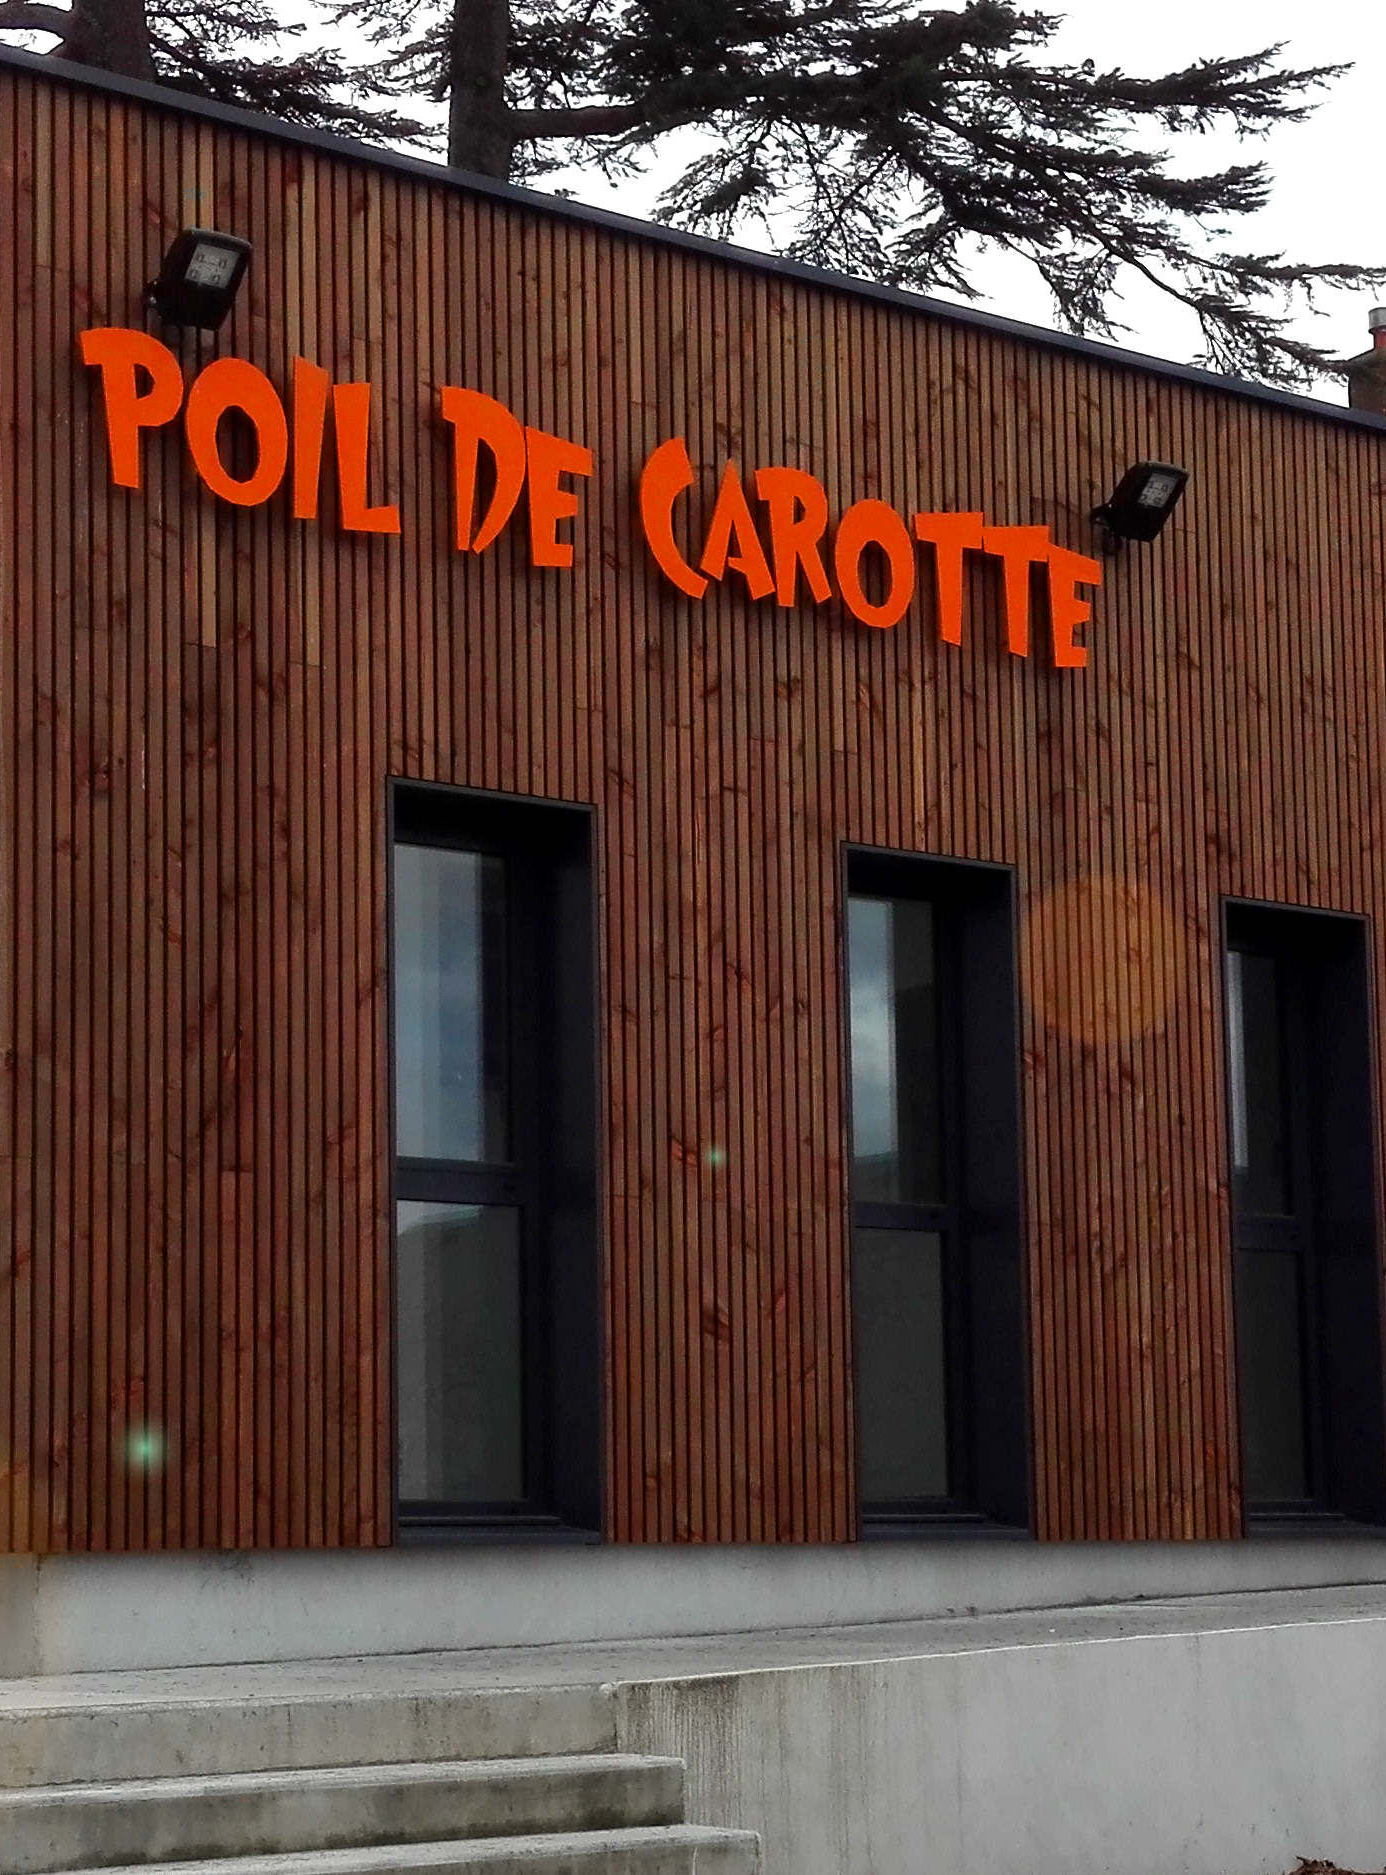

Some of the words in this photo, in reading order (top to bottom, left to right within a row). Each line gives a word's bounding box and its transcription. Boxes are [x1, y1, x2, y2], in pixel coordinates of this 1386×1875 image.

[81, 327, 401, 535] POIL
[441, 386, 593, 567] DE
[641, 438, 1101, 668] CAROTTE
